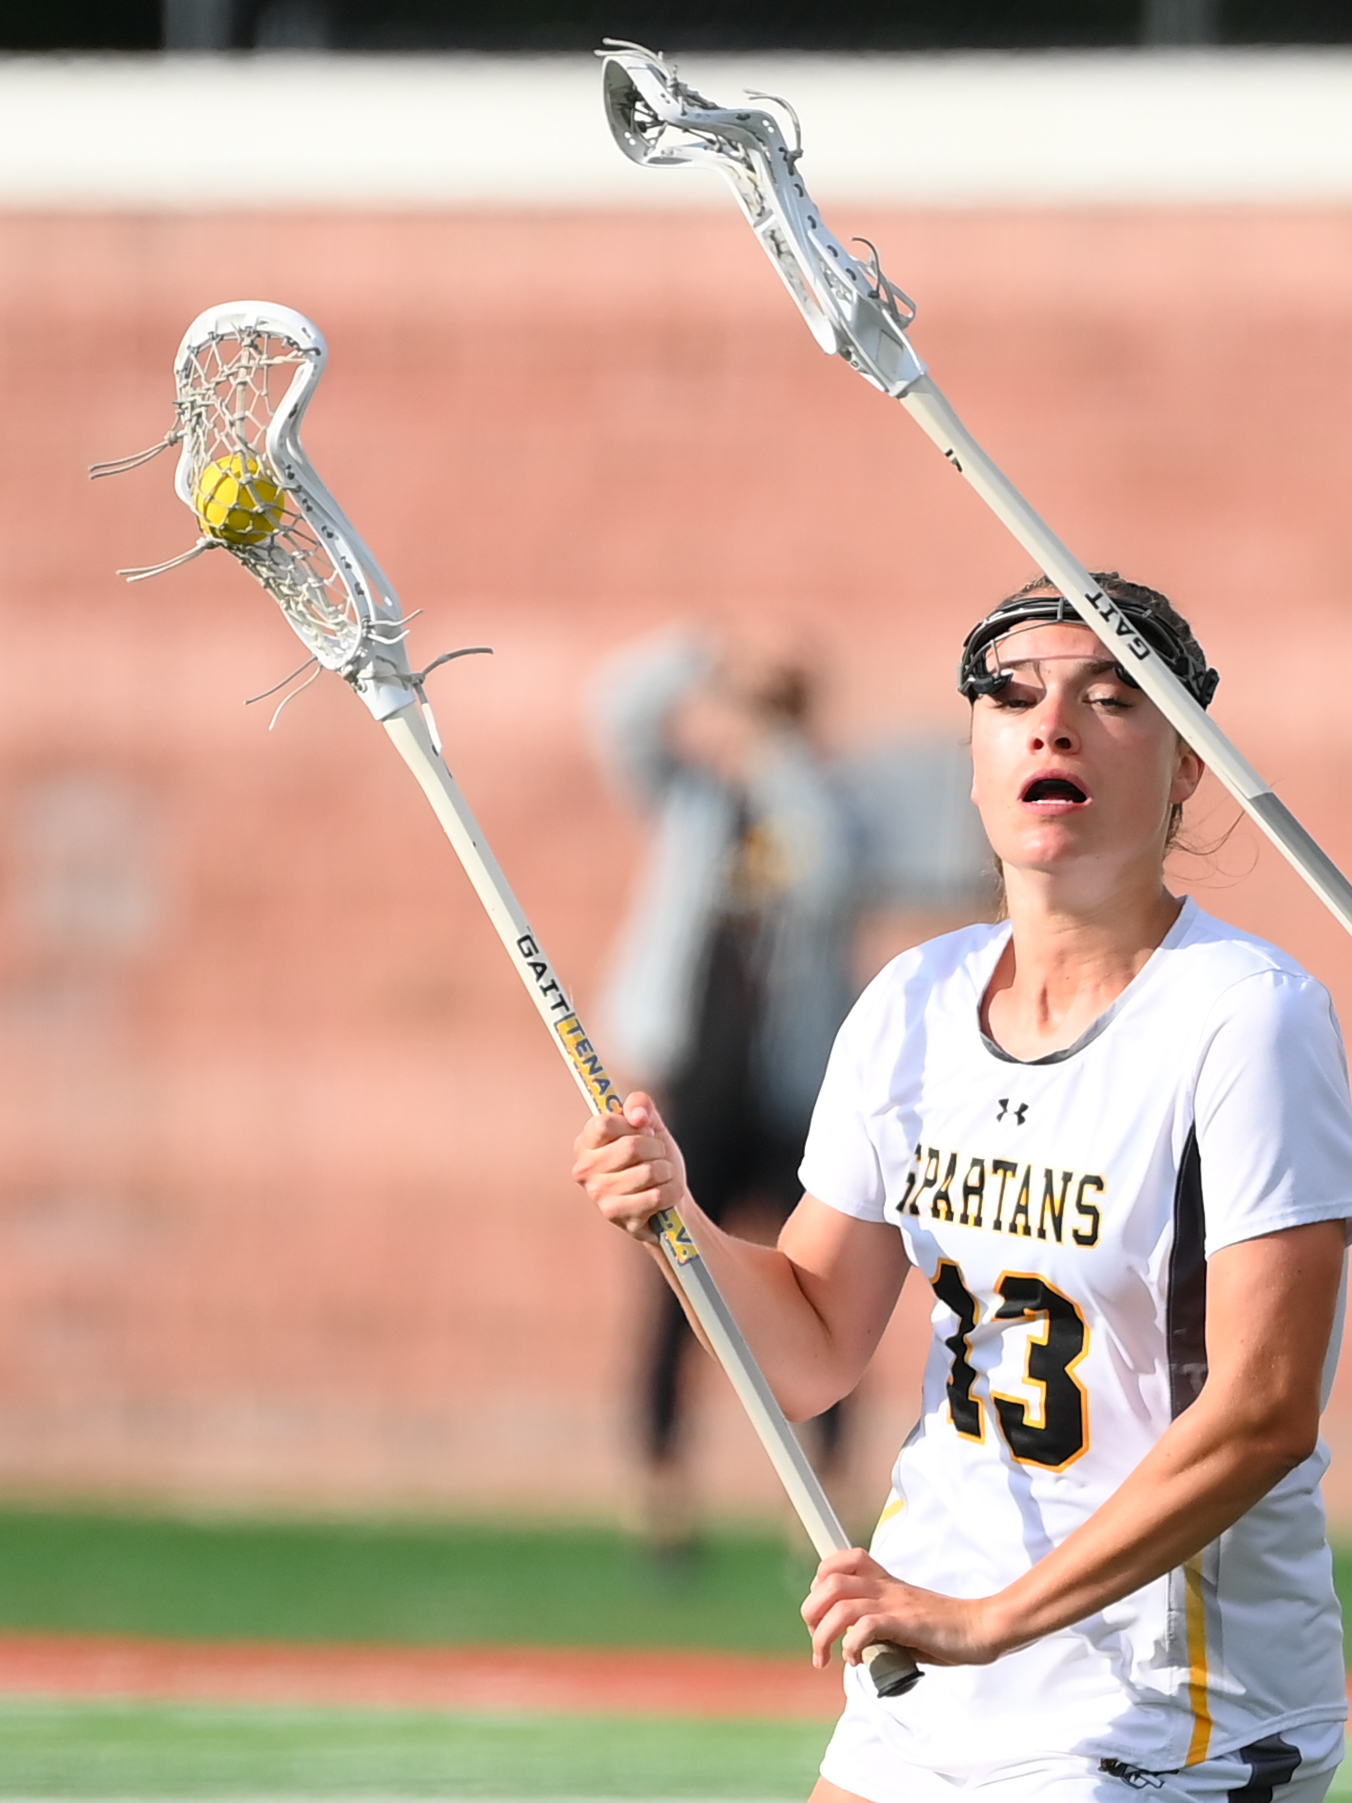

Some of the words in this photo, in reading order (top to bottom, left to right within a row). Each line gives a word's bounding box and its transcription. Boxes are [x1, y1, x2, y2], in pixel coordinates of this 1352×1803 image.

[1084, 591, 1151, 661] GAIT
[516, 934, 570, 1012] GAIT
[566, 1018, 624, 1113] TENAC
[931, 1257, 1090, 1473] 13
